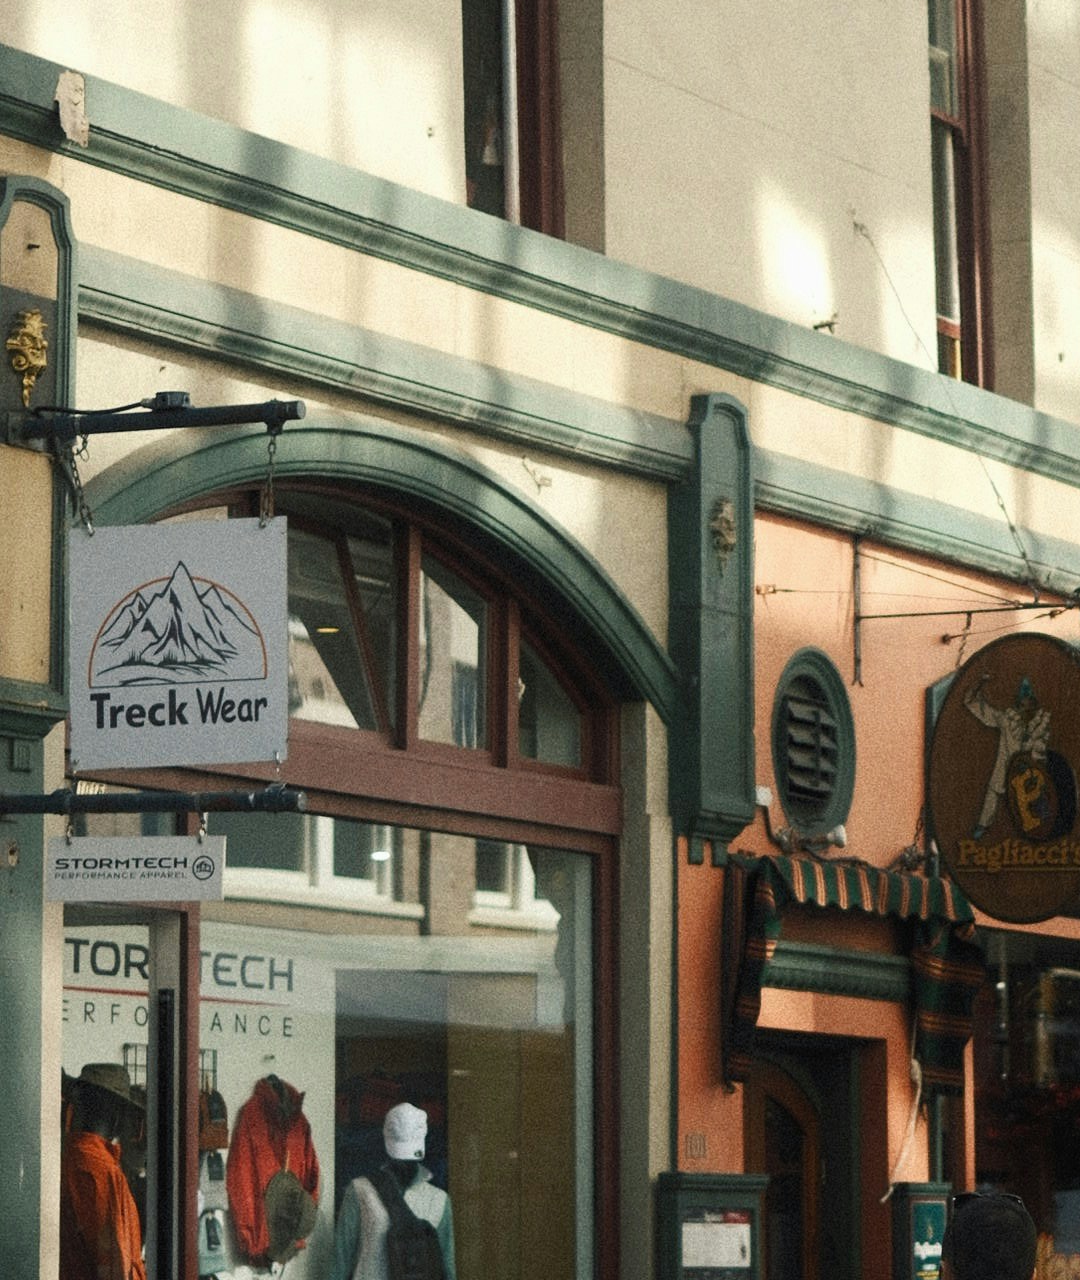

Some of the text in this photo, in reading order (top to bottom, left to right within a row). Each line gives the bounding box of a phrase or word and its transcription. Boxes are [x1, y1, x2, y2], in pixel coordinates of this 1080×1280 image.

[90, 686, 268, 729] Treck Wear
[55, 857, 188, 870] STORMTECH
[54, 870, 187, 880] PERFORMANCE APPAREL
